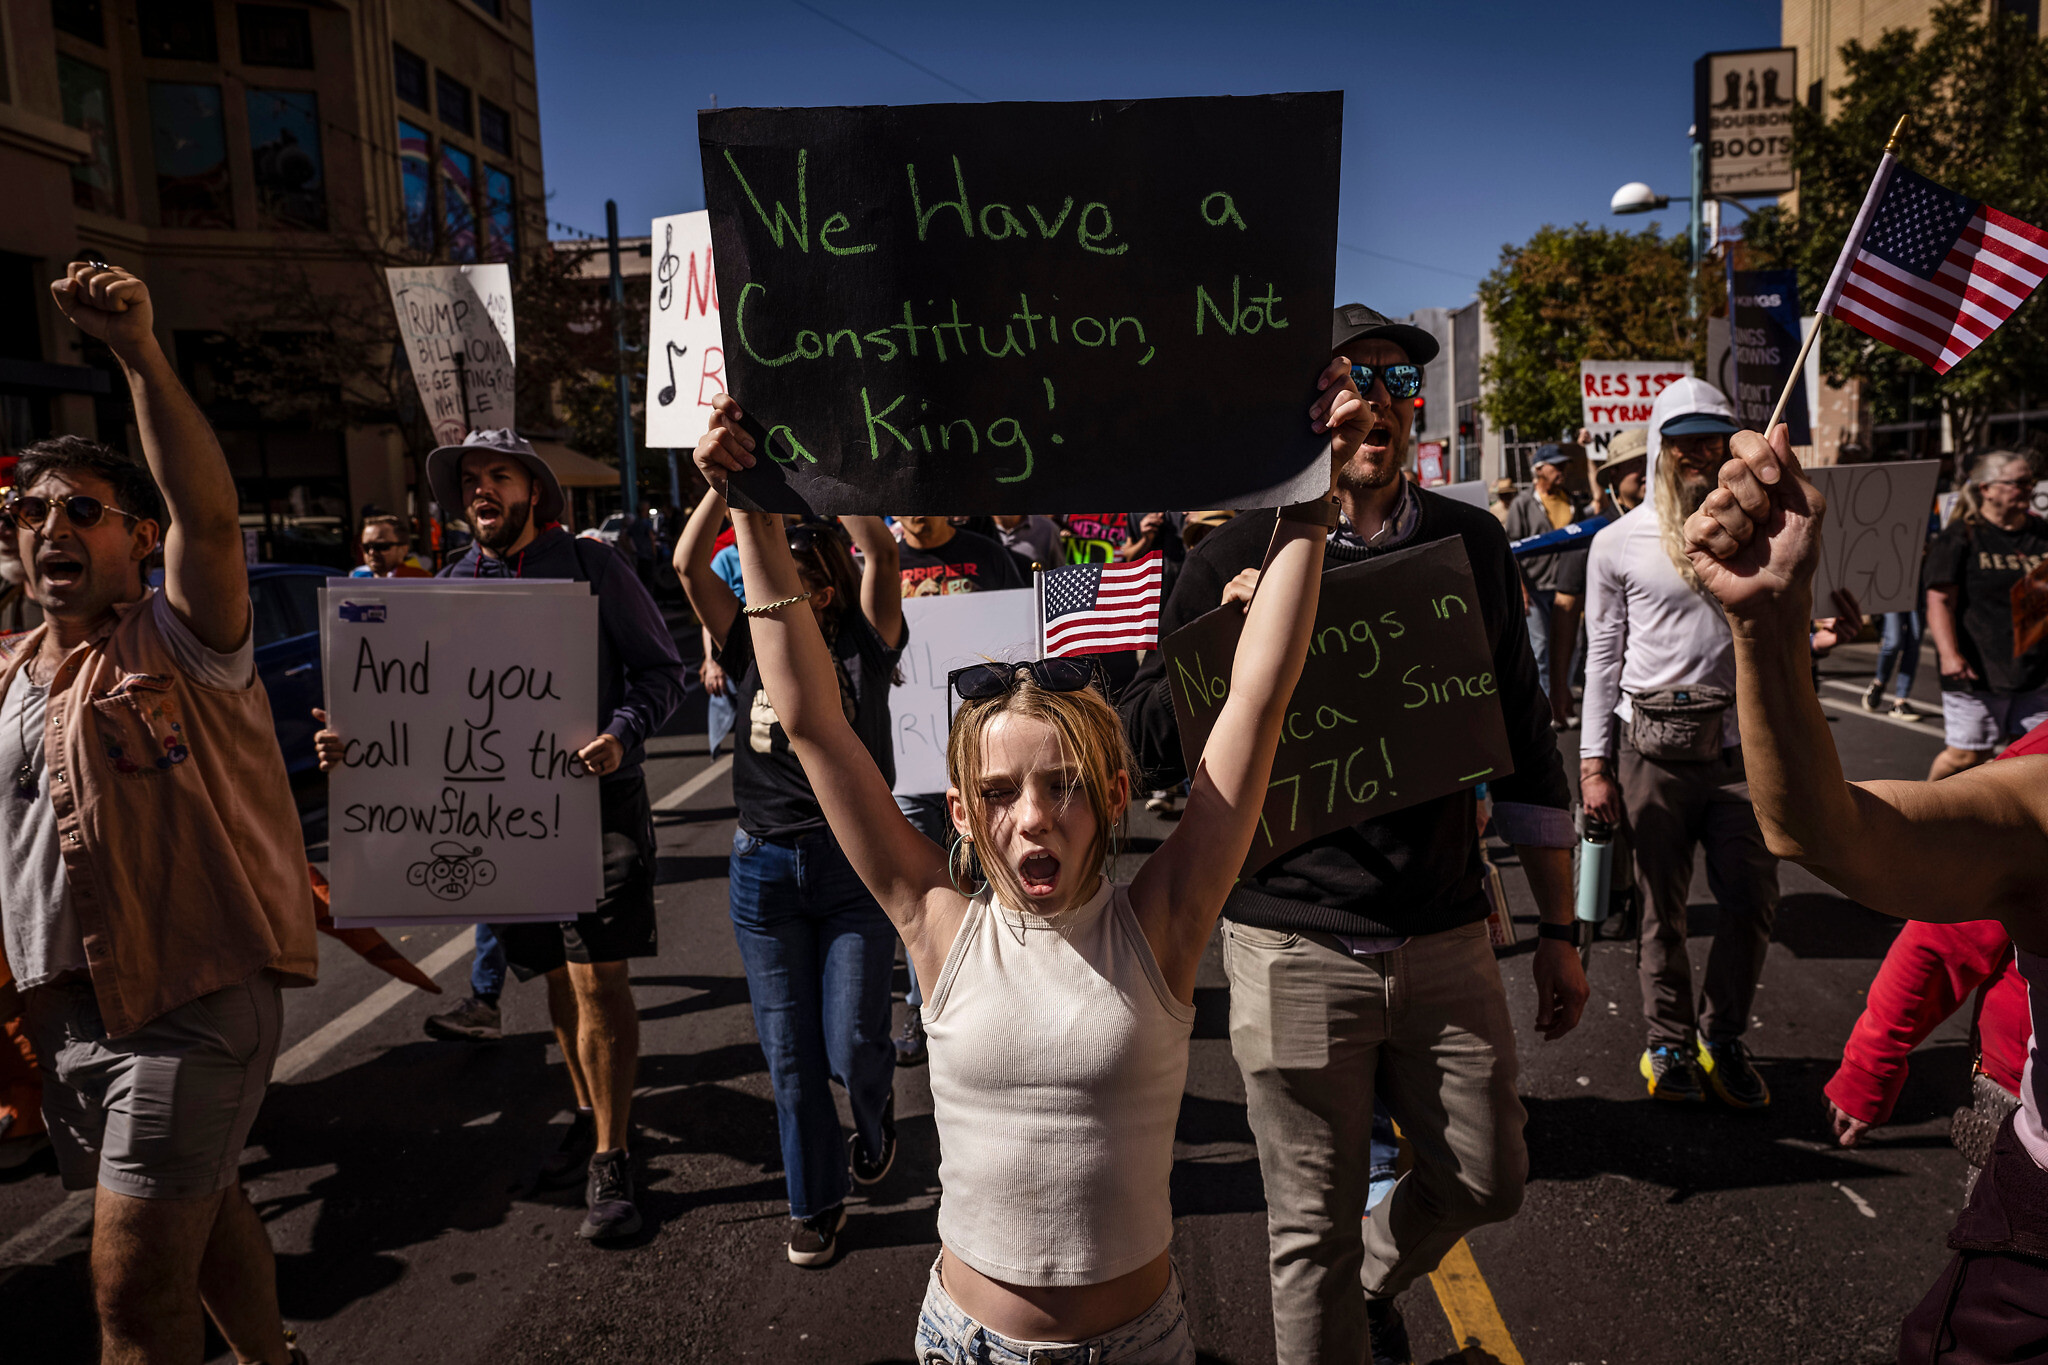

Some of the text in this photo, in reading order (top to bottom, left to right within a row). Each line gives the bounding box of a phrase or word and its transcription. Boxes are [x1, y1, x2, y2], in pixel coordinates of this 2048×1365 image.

[1711, 136, 1791, 158] BOOTS
[723, 149, 1247, 256] We Have a
[397, 289, 469, 336] TRUMP
[736, 278, 1289, 367] Constitution, Not
[1584, 373, 1686, 397] RESIS
[765, 378, 1064, 483] a King!
[1589, 404, 1653, 424] TYRAN
[1824, 467, 1892, 527] NO
[1069, 520, 1126, 542] MERICA
[900, 562, 980, 583] RRIFIER
[353, 636, 562, 730] And you
[1175, 595, 1467, 717] No ings in
[1402, 664, 1497, 709] Since
[343, 720, 409, 768] call
[528, 730, 585, 780] the
[344, 787, 560, 841] snowflakes!
